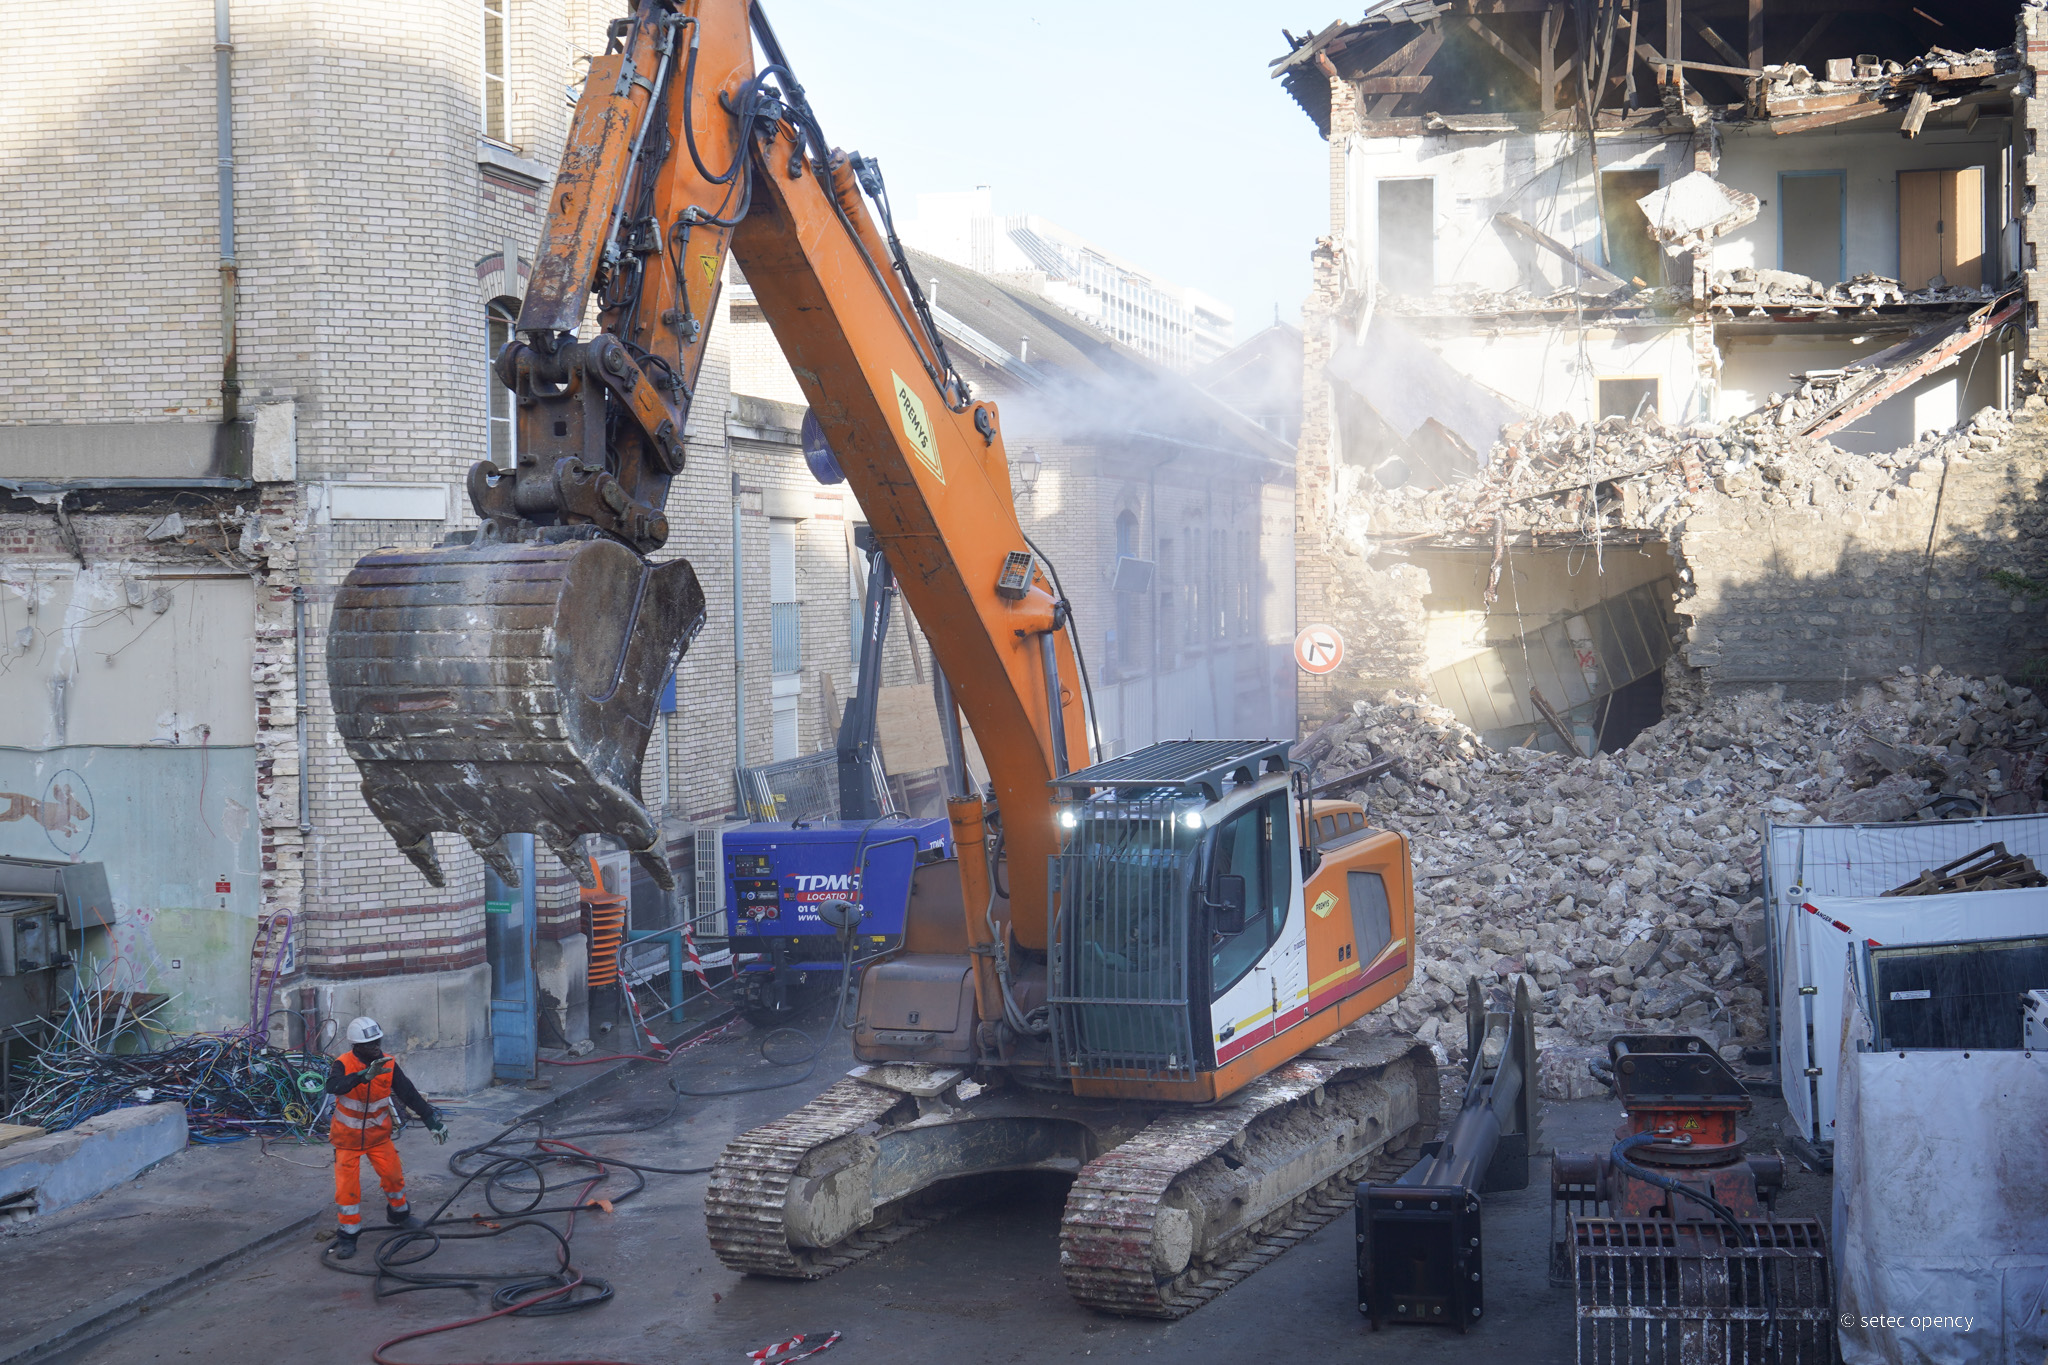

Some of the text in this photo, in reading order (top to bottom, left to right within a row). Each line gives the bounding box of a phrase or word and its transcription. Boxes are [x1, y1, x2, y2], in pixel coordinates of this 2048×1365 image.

[899, 388, 928, 448] PREMYS
[795, 874, 863, 891] TPMS
[797, 905, 808, 913] 01
